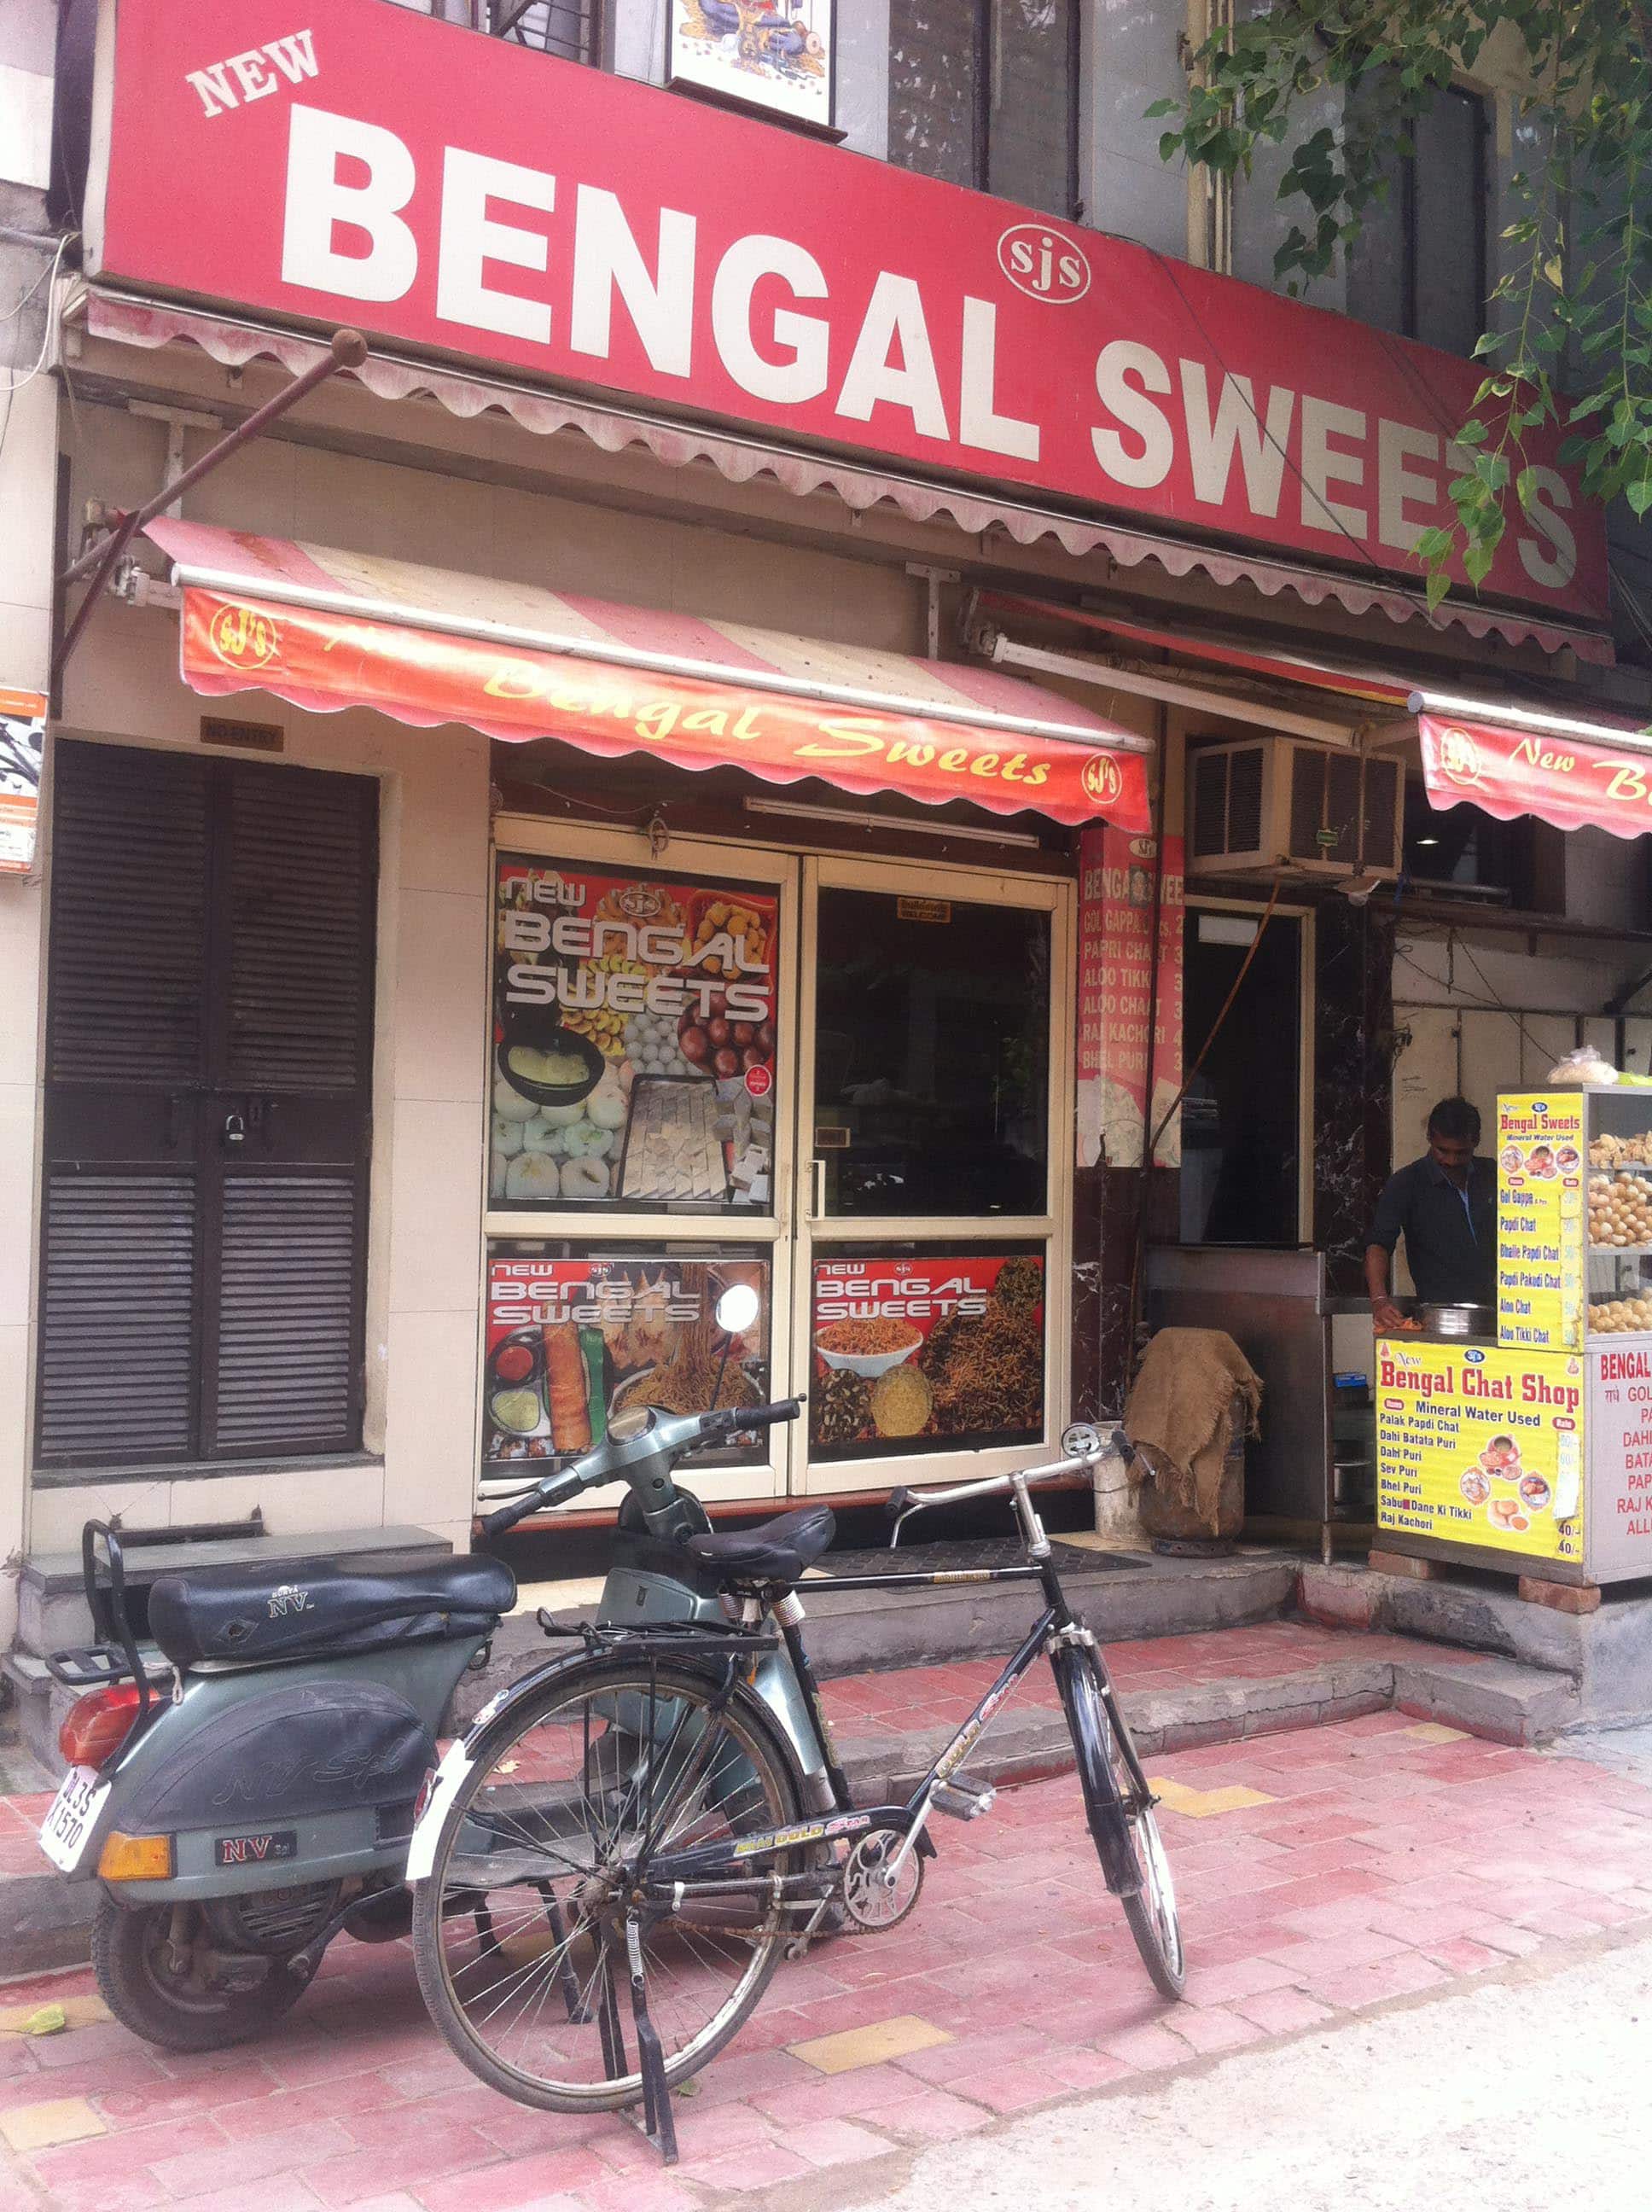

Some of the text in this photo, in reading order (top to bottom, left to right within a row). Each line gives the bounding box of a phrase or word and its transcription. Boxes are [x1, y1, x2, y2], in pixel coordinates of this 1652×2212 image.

[185, 28, 320, 119] NEW
[281, 102, 1040, 463] BENGAL
[481, 657, 1051, 786] Bengal Sweets
[1508, 737, 1575, 771] New
[505, 876, 586, 908] NEW
[504, 910, 770, 975] BENGAL
[1120, 968, 1151, 988] TIKK
[506, 963, 770, 1022] SWEETS
[1501, 1114, 1580, 1133] Bengal Sweets
[1521, 1218, 1536, 1232] Chat
[1543, 1245, 1559, 1260] Chat
[491, 1263, 553, 1276] NEW
[814, 1263, 865, 1275] NEW
[491, 1279, 701, 1301] BENGAL
[816, 1277, 987, 1298] BENGAL
[1544, 1273, 1561, 1289] Chat
[492, 1303, 701, 1325] SWEETS
[817, 1298, 987, 1320] SWEETS
[1515, 1299, 1532, 1314] Chat
[1515, 1326, 1532, 1342] Tikki
[1533, 1328, 1550, 1343] Chat
[1600, 1351, 1651, 1381] BENGAL
[1381, 1359, 1454, 1398] Bengal
[1462, 1368, 1513, 1400] Chat
[1521, 1374, 1579, 1413] Shop
[1380, 1413, 1460, 1433] Palak Papdi Chat
[1416, 1400, 1461, 1417] Mineral
[1465, 1406, 1504, 1423] Water
[1507, 1411, 1541, 1427] Used
[1380, 1429, 1400, 1442] Dahi
[1403, 1432, 1434, 1447] Batata
[1437, 1435, 1456, 1450] Puri
[1403, 1449, 1422, 1462] Puri
[1380, 1462, 1418, 1478] Sev Puri
[1380, 1479, 1422, 1495] Bhel Puri
[1411, 1499, 1434, 1514] Dane
[1437, 1503, 1446, 1516] Ki
[1449, 1505, 1472, 1520] Tikki
[1616, 1498, 1642, 1514] RAJ
[1380, 1511, 1395, 1525] Raj
[1398, 1515, 1433, 1530] Kachori
[267, 1591, 309, 1619] NV
[222, 1835, 273, 1864] NV
